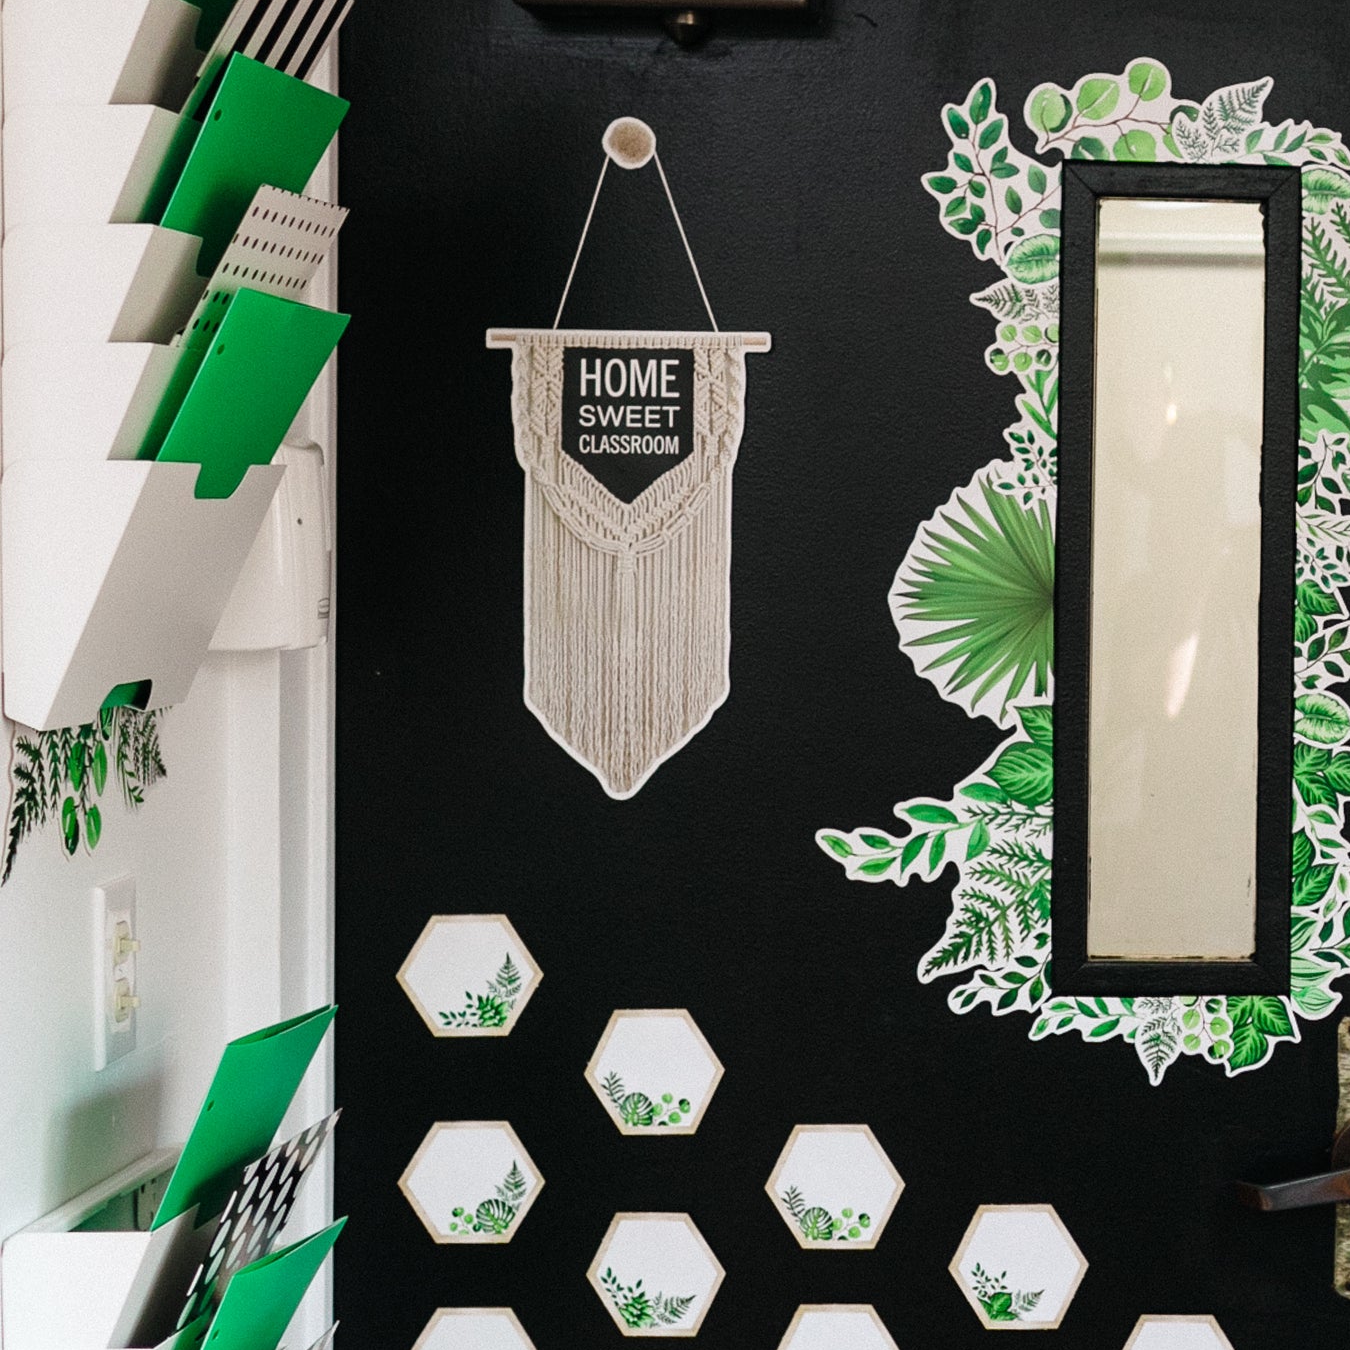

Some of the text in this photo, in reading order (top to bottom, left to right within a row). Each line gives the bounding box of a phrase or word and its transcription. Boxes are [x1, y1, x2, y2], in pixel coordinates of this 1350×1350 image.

[580, 358, 680, 398] HOME
[578, 404, 681, 428] SWEET
[578, 434, 680, 455] CLASSROOM
